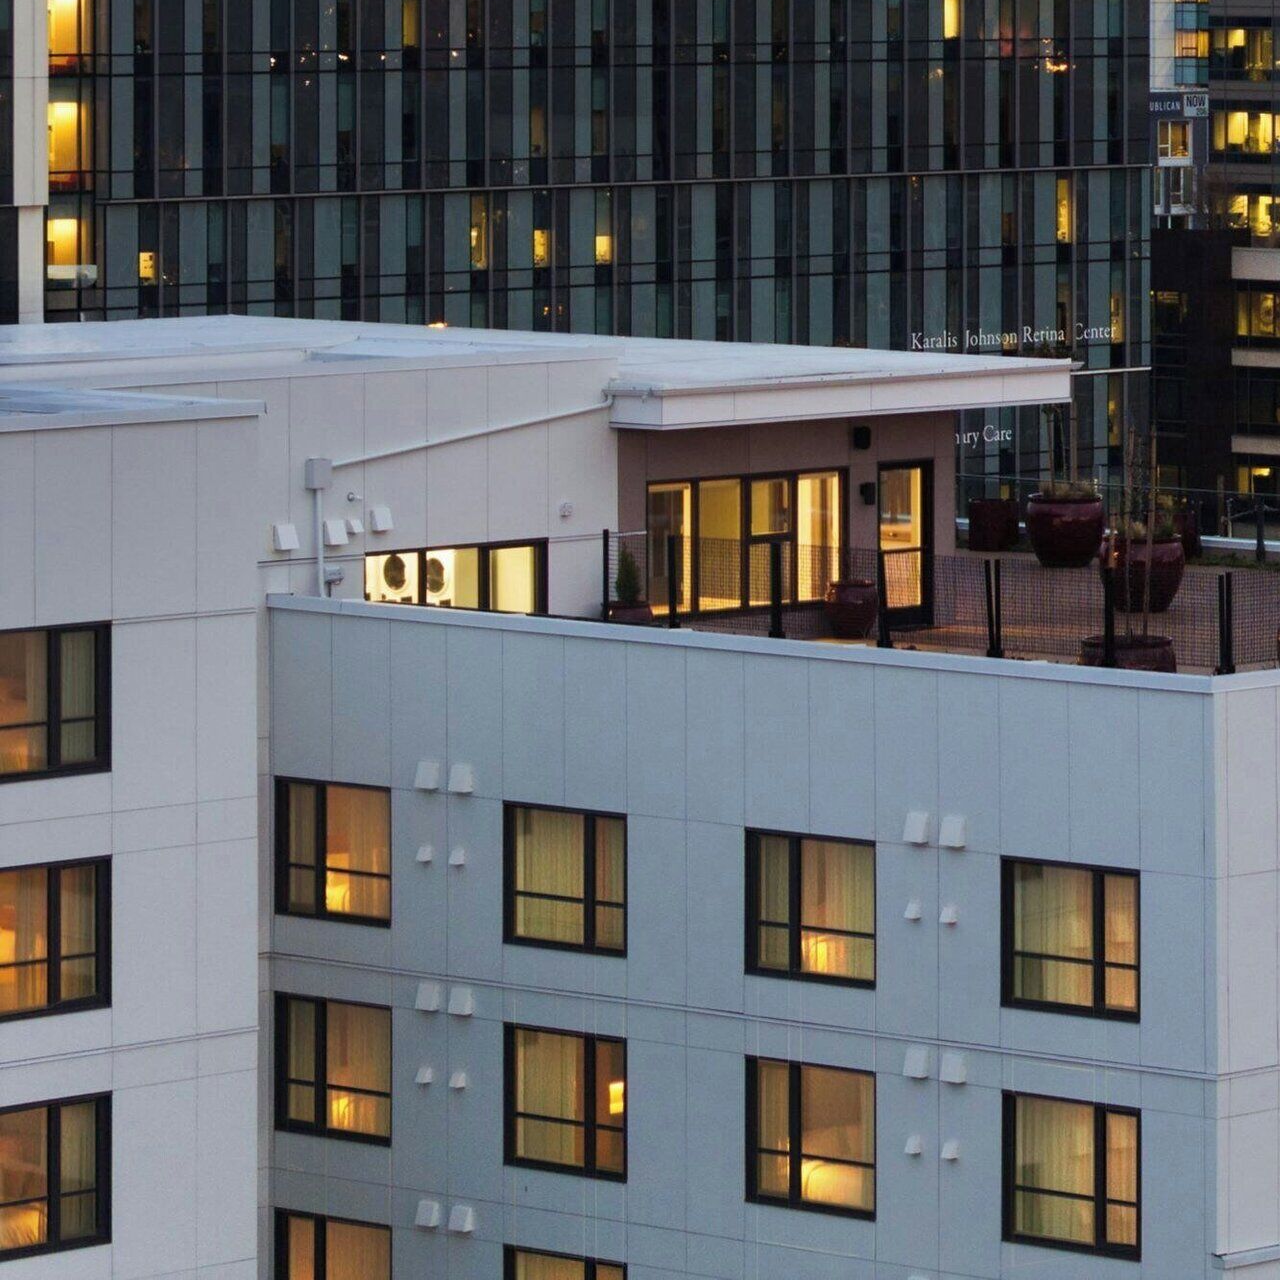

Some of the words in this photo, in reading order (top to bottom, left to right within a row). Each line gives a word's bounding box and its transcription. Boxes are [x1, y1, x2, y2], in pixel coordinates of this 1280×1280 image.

[1186, 95, 1205, 107] NOW
[911, 329, 958, 350] Karalis
[965, 328, 1018, 348] Johnson
[1023, 325, 1066, 343] Retina
[1075, 322, 1117, 340] Center
[983, 425, 1013, 442] Care
